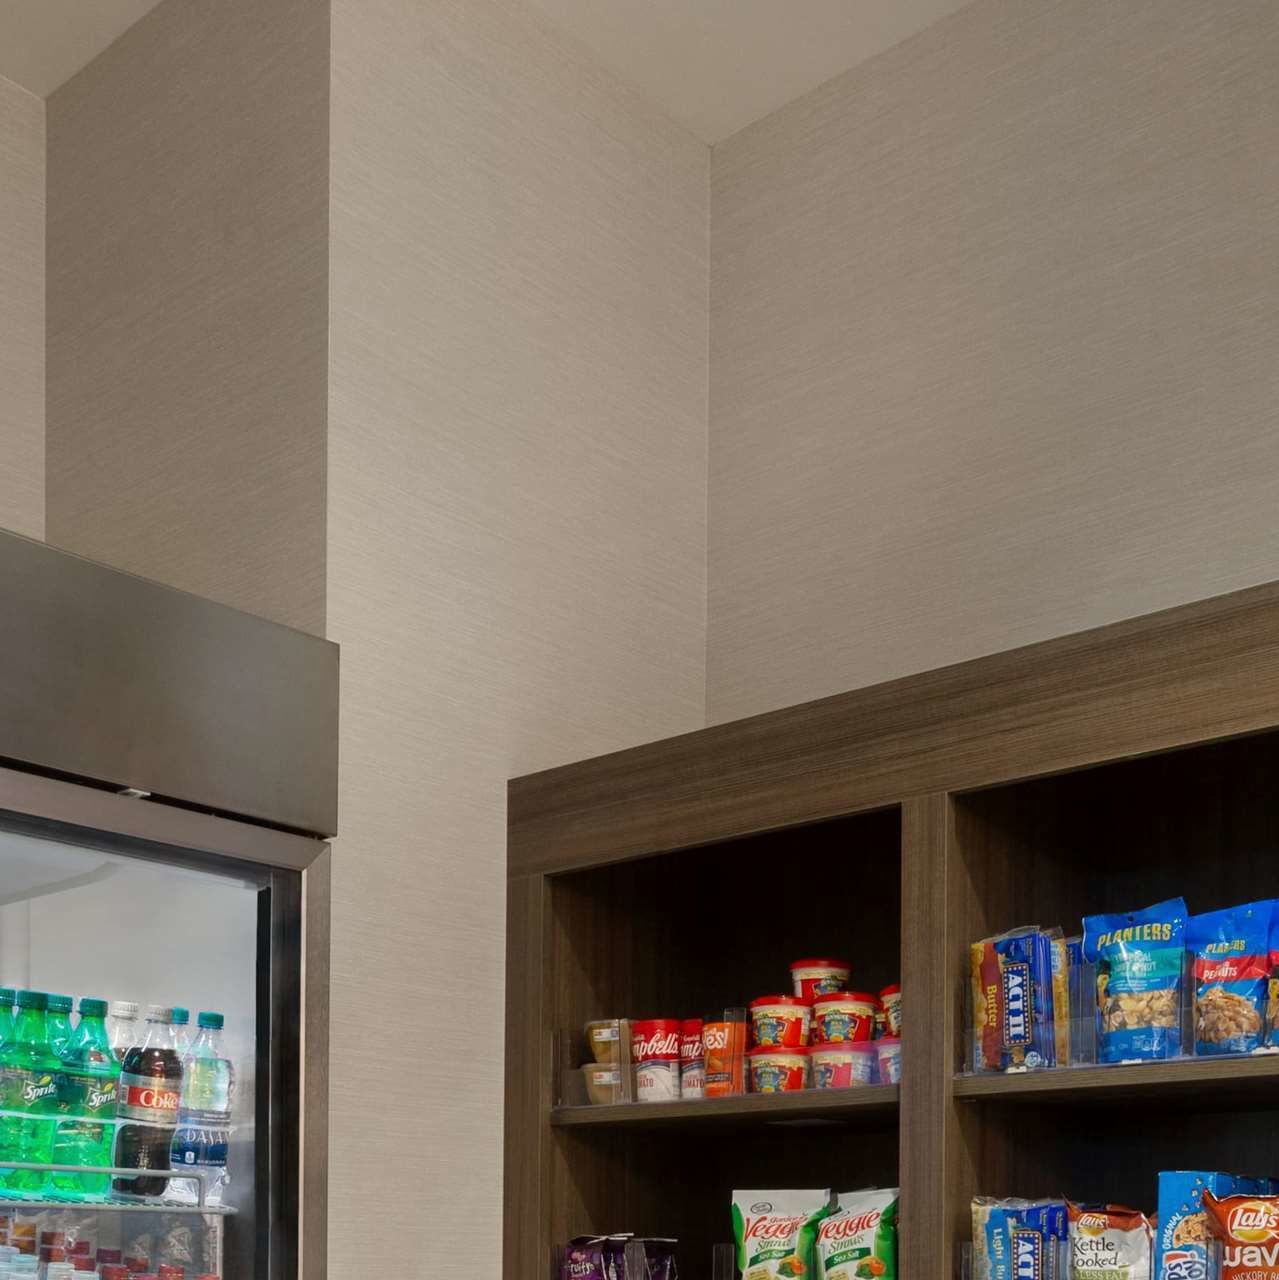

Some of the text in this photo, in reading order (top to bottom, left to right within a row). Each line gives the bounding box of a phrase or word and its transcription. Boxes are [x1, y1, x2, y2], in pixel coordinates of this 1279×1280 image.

[1097, 924, 1172, 951] PLANTERS
[986, 984, 997, 1027] Butter
[1008, 973, 1024, 1037] ACT II
[140, 1090, 178, 1108] Coke
[1162, 1212, 1183, 1250] ORIGINAL
[1231, 1206, 1279, 1230] Lay's
[992, 1227, 1004, 1260] Light
[1072, 1237, 1115, 1251] Kettle
[1017, 1239, 1034, 1280] ACT
[1081, 1270, 1124, 1280] LESS FAT
